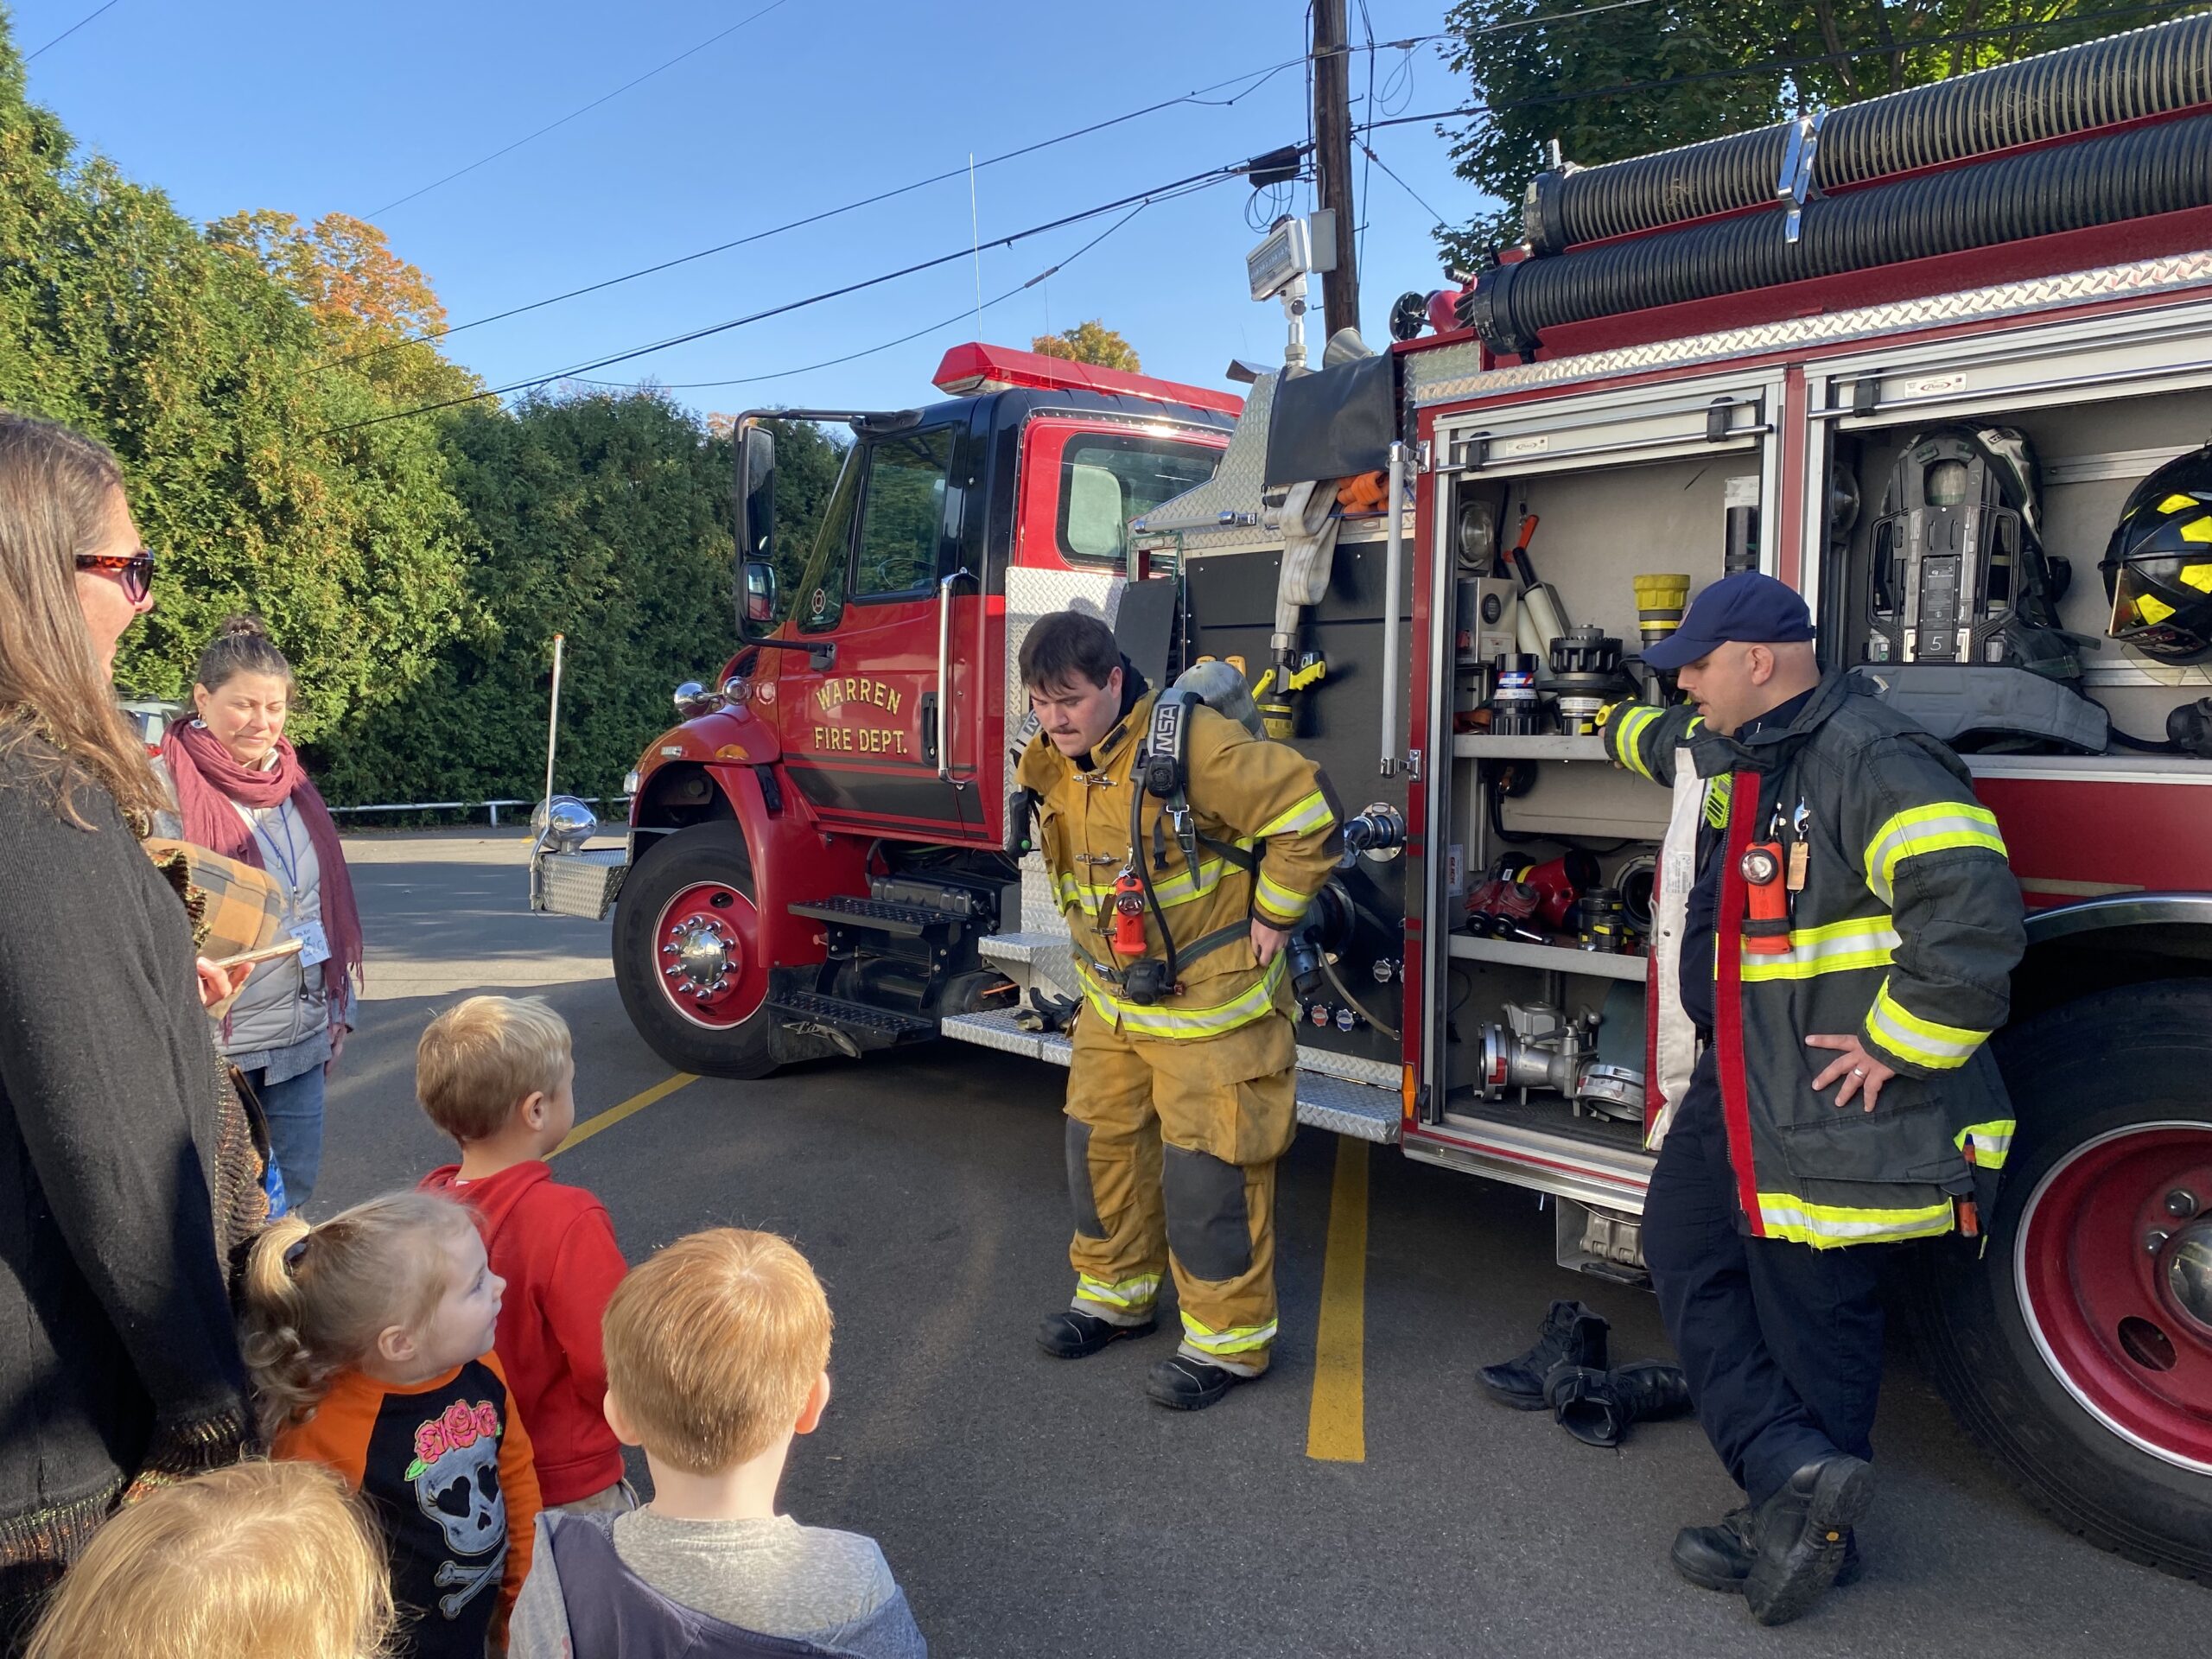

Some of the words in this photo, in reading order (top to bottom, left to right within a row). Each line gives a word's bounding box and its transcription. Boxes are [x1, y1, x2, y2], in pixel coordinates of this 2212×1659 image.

[1929, 636, 1943, 651] 5
[816, 678, 901, 715] WARREN
[814, 727, 852, 751] FIRE
[858, 728, 907, 754] DEPT.
[1156, 706, 1177, 751] MSA
